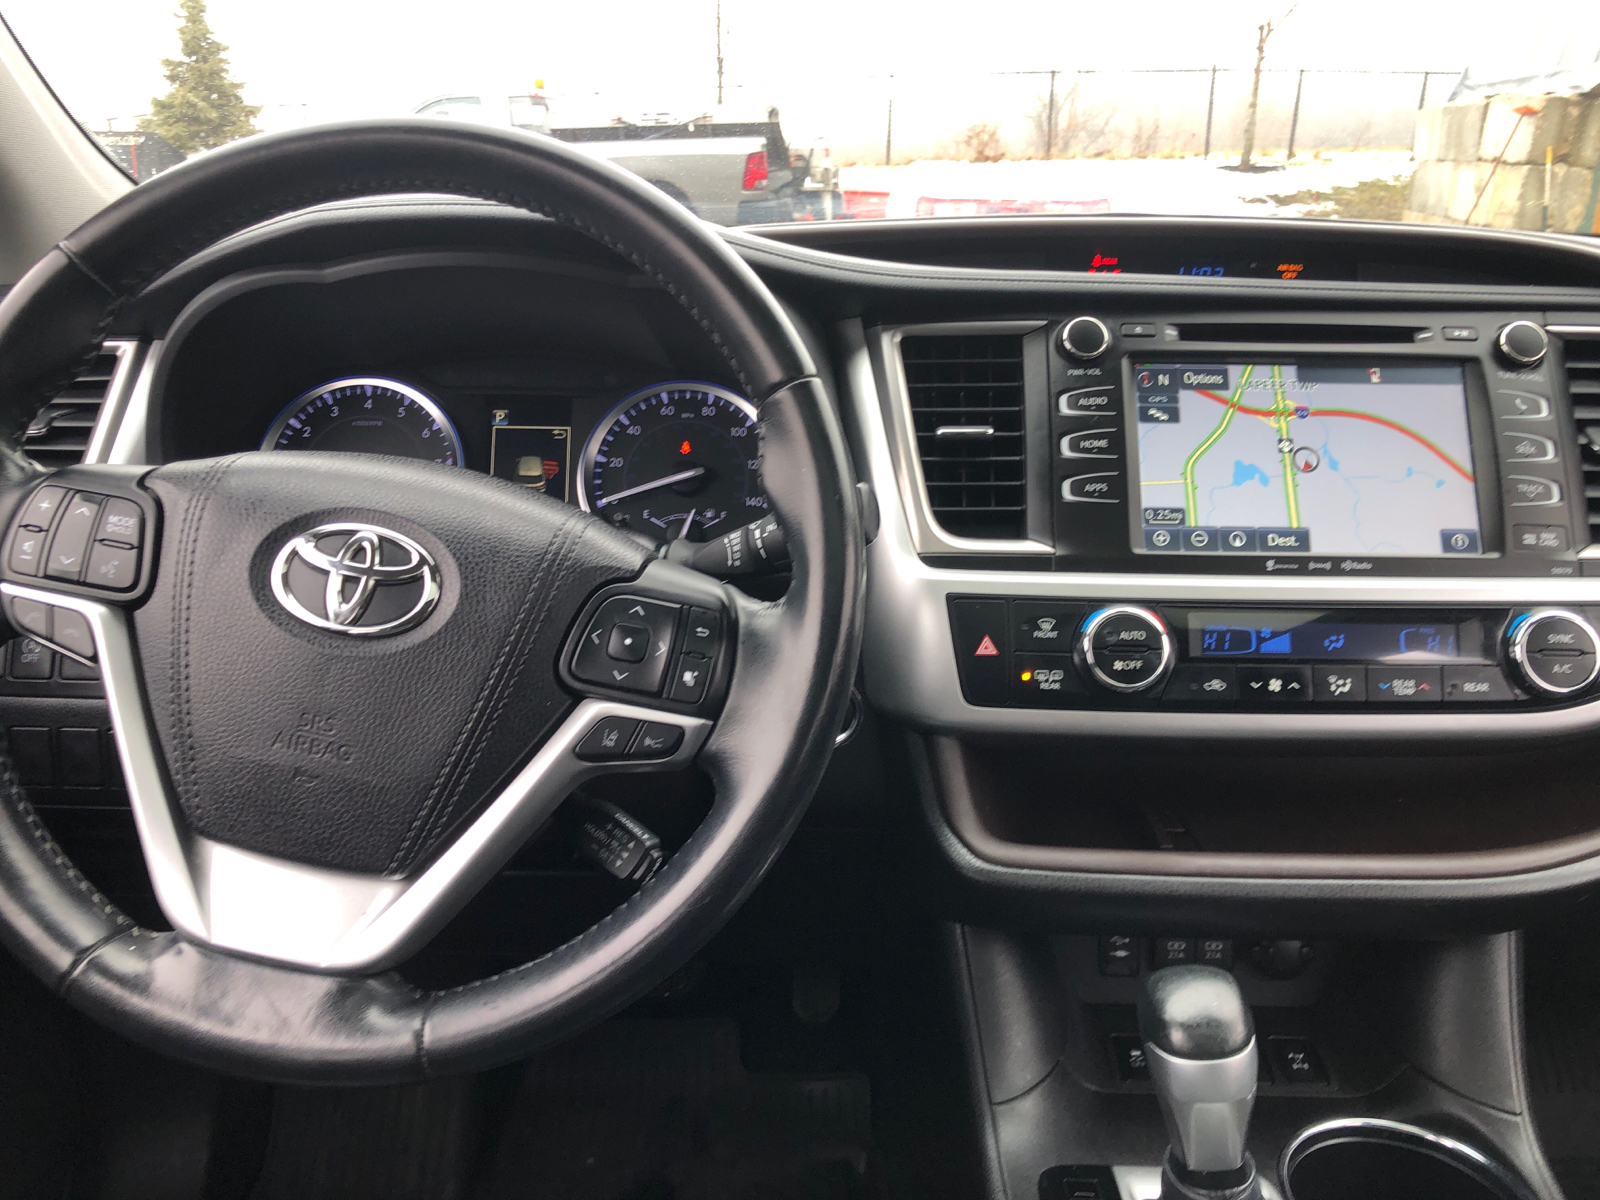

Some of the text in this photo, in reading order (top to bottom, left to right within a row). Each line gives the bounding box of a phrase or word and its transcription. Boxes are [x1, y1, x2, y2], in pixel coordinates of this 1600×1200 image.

[1157, 374, 1170, 386] N
[1183, 371, 1224, 386] Options
[364, 399, 374, 410] 4
[1077, 396, 1109, 407] AUDIO
[330, 405, 340, 417] 3
[396, 406, 406, 418] 5
[660, 405, 675, 416] 60
[701, 406, 717, 417] 80
[495, 411, 506, 422] P
[302, 426, 311, 437] 2
[421, 427, 431, 438] 6
[626, 425, 642, 436] 40
[730, 426, 748, 437] 100
[1080, 439, 1109, 449] HOME
[609, 457, 623, 468] 20
[748, 459, 759, 469] 12
[1084, 483, 1109, 493] APPS
[744, 496, 763, 507] 140
[643, 509, 650, 519] E
[720, 511, 728, 520] F
[108, 514, 137, 527] MODE
[1267, 533, 1301, 547] Dest.
[1033, 630, 1059, 639] FRONT
[1119, 630, 1147, 641] AUTO
[1547, 633, 1575, 644] SYNC
[1122, 660, 1144, 671] OFF
[1551, 663, 1573, 674] A/C
[1040, 682, 1061, 690] REAR
[1392, 679, 1416, 688] REAR
[1463, 682, 1490, 692] REAR
[270, 729, 353, 764] AIRBAG
